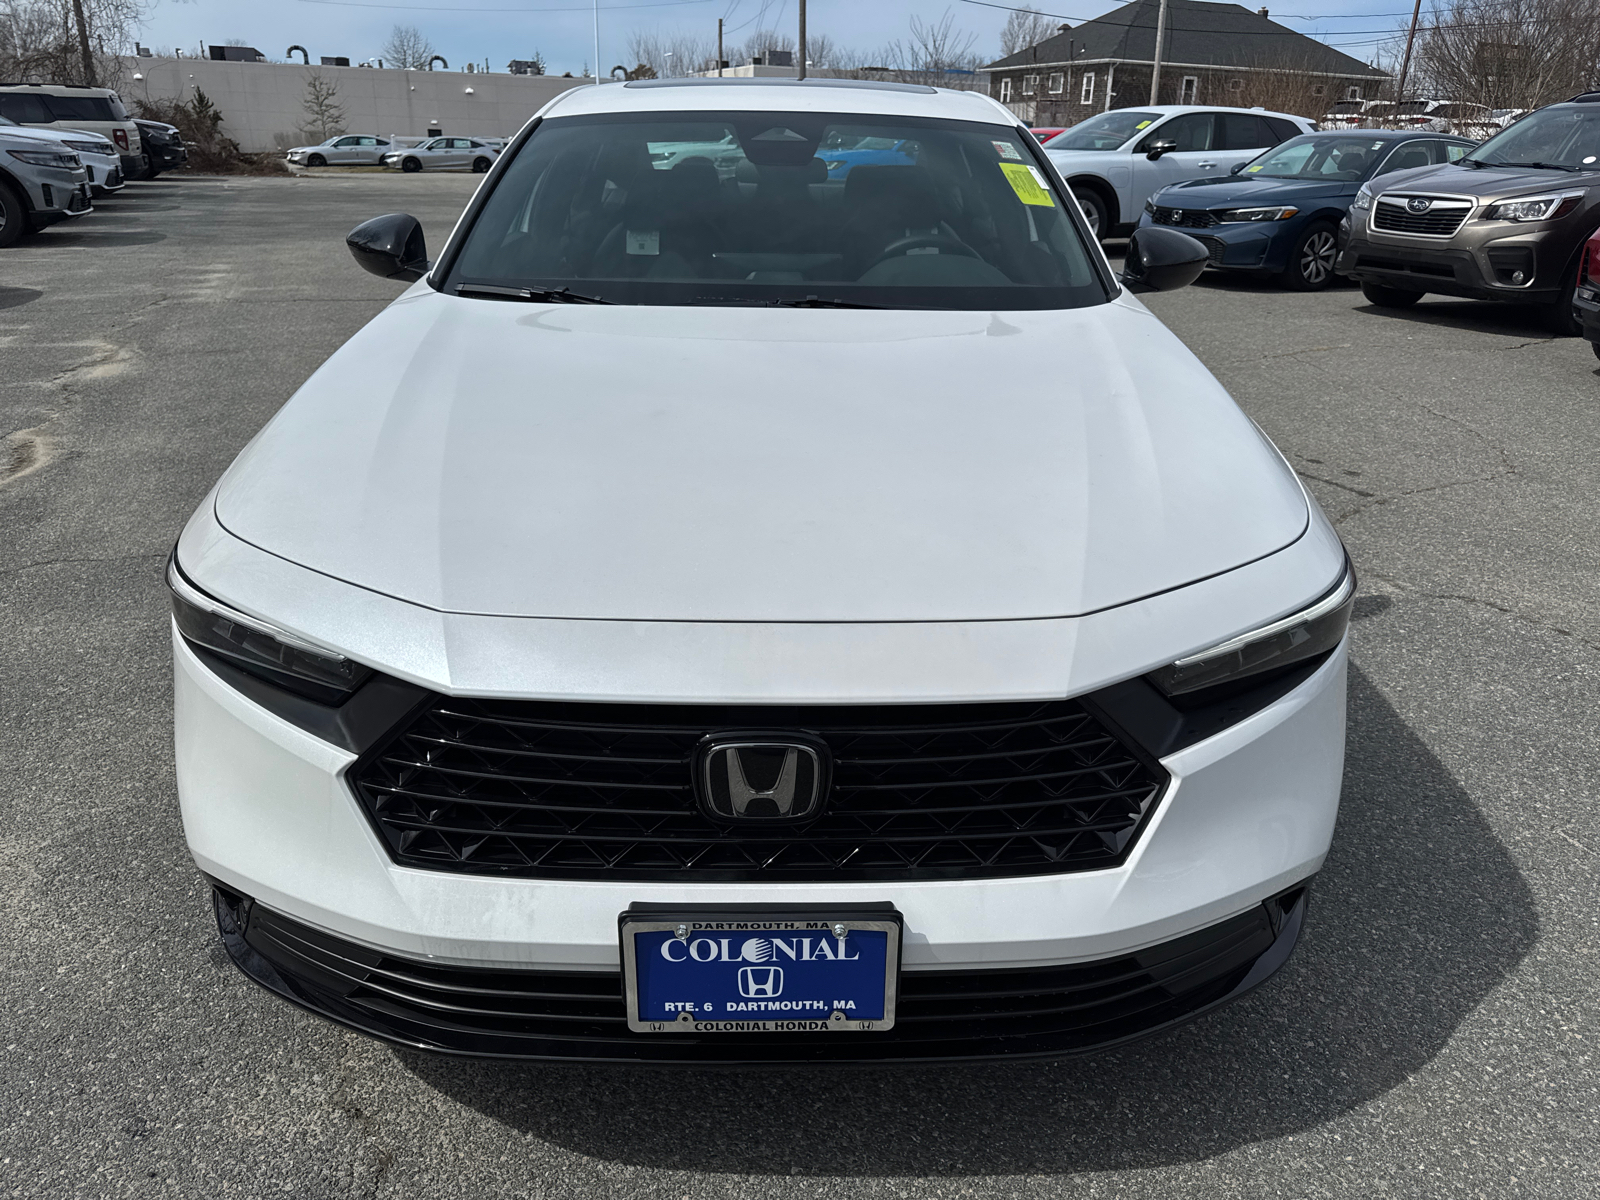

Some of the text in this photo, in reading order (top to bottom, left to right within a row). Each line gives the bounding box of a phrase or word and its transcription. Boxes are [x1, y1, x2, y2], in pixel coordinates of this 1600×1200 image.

[692, 922, 800, 930] DARTMOUTH,
[660, 937, 860, 963] COLONIAL
[664, 1000, 857, 1012] RTE. 6 DARTMOUTH, MA
[694, 1021, 829, 1031] COLONIAL HONDA
